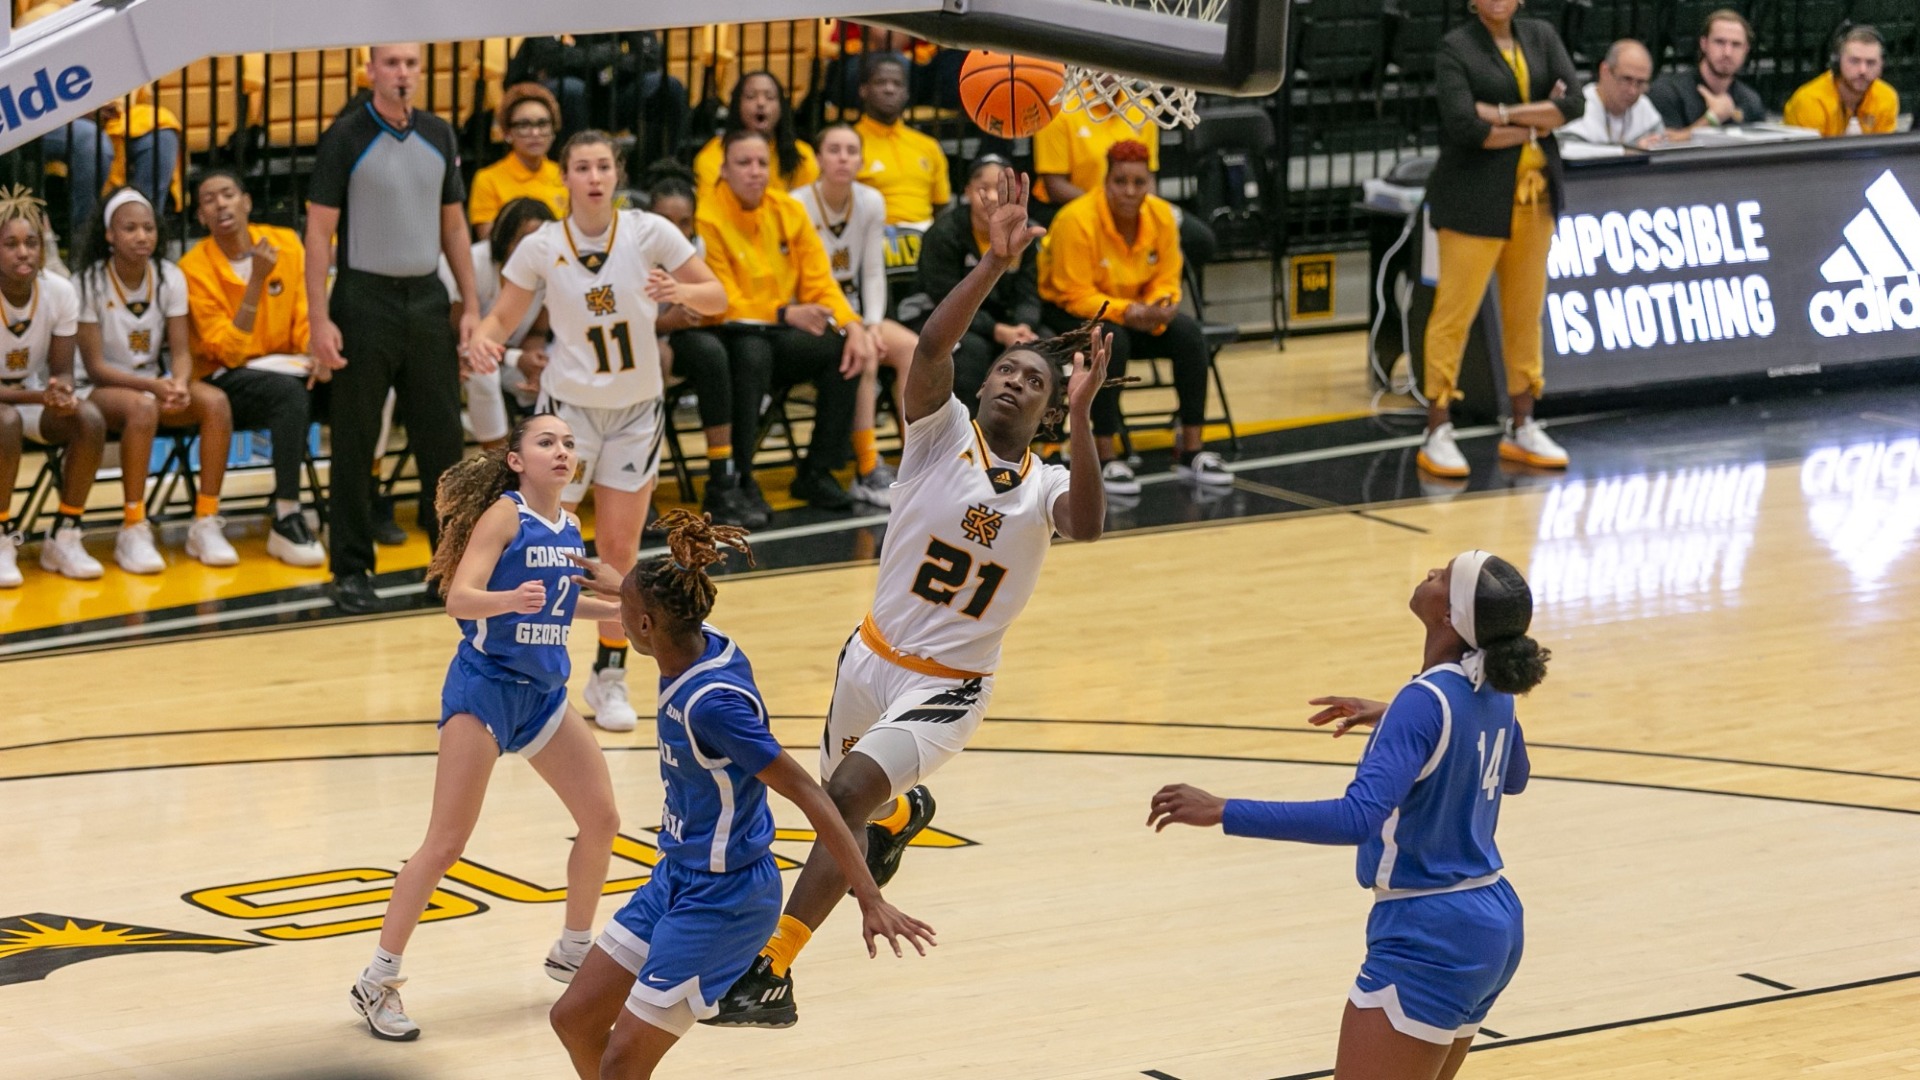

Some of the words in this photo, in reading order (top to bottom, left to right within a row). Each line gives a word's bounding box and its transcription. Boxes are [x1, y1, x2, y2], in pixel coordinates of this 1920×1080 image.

[0, 65, 93, 133] lde
[1547, 201, 1770, 279] MPOSSIBLE
[1547, 290, 1595, 355] IS
[1593, 274, 1775, 351] NOTHING
[1809, 270, 1920, 337] adid
[586, 321, 636, 374] 11
[526, 546, 586, 569] COASTA
[909, 533, 1009, 621] 21
[551, 575, 571, 617] 2
[515, 623, 570, 646] GEORG
[1477, 727, 1506, 801] 14
